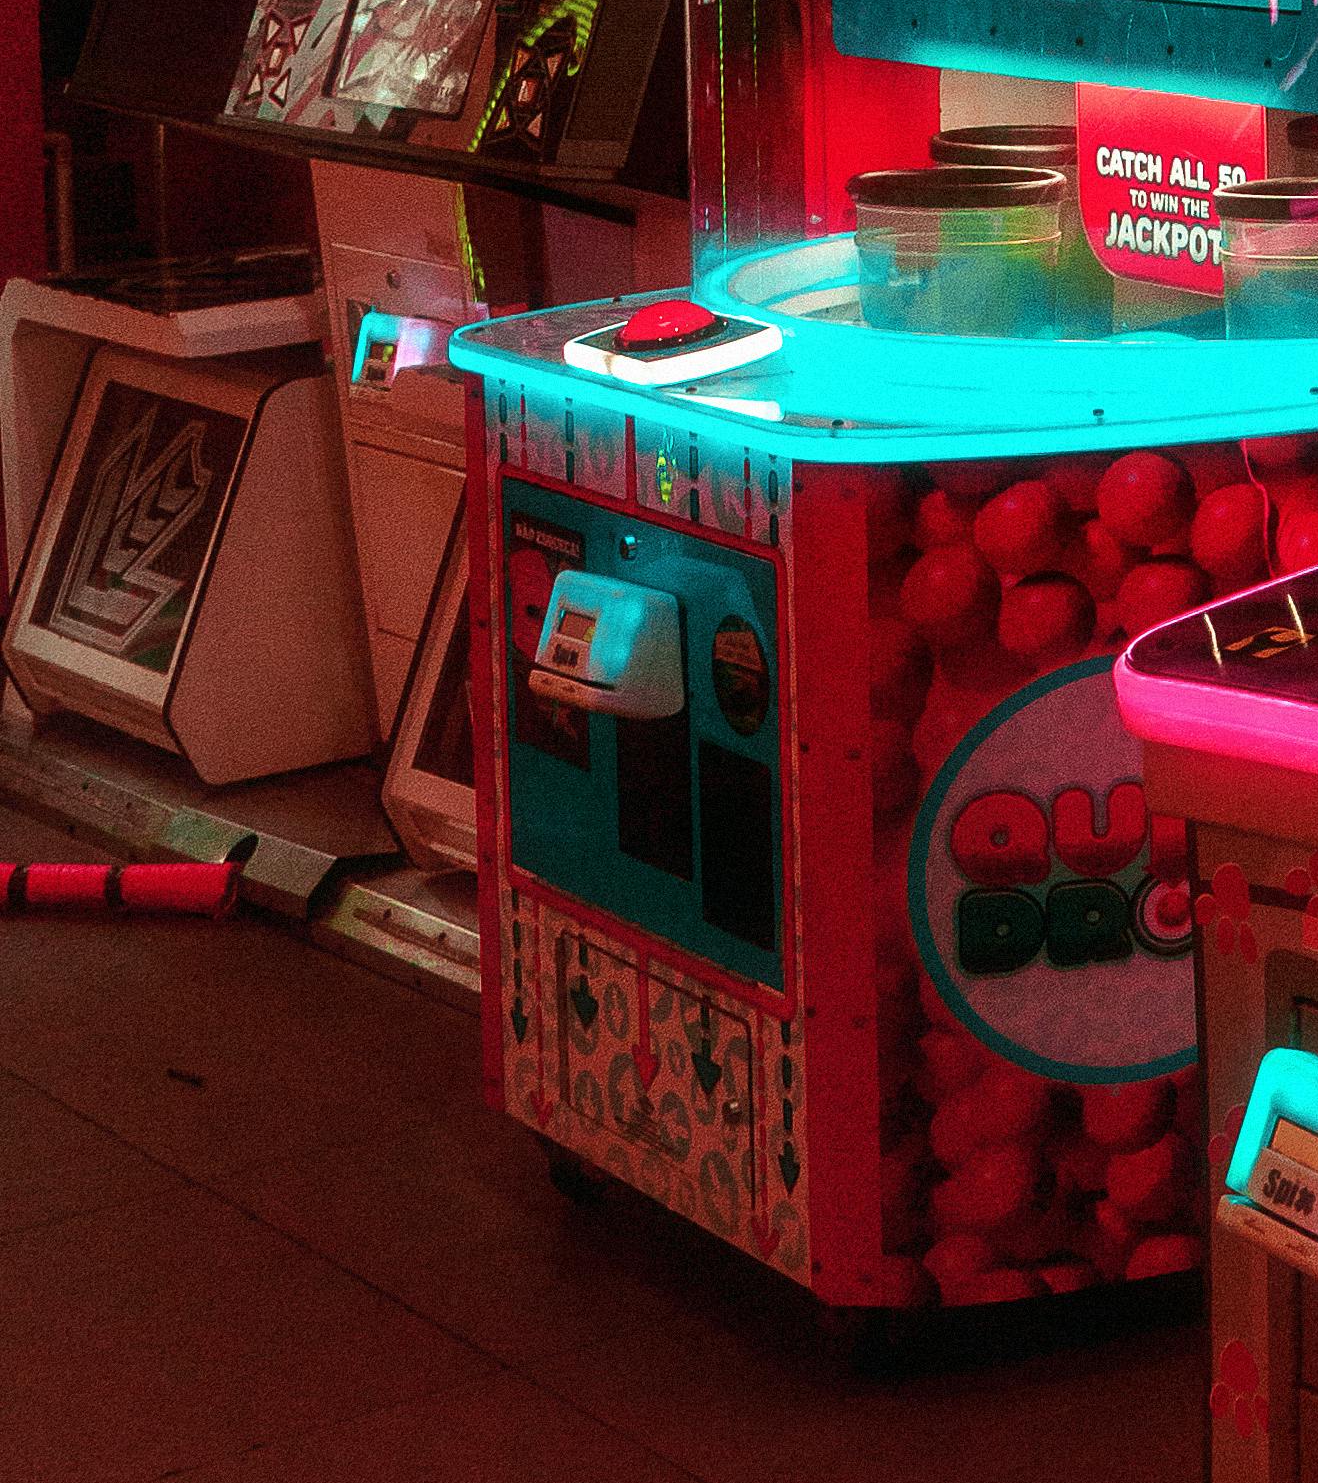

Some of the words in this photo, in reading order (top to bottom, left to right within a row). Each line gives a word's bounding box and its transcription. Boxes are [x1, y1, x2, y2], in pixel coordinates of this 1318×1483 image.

[1097, 147, 1163, 183] CATCH
[1169, 160, 1211, 190] ALL
[1130, 189, 1148, 207] TO
[1150, 191, 1179, 214] WIN
[1182, 197, 1209, 218] THE
[958, 879, 1194, 978] DRO
